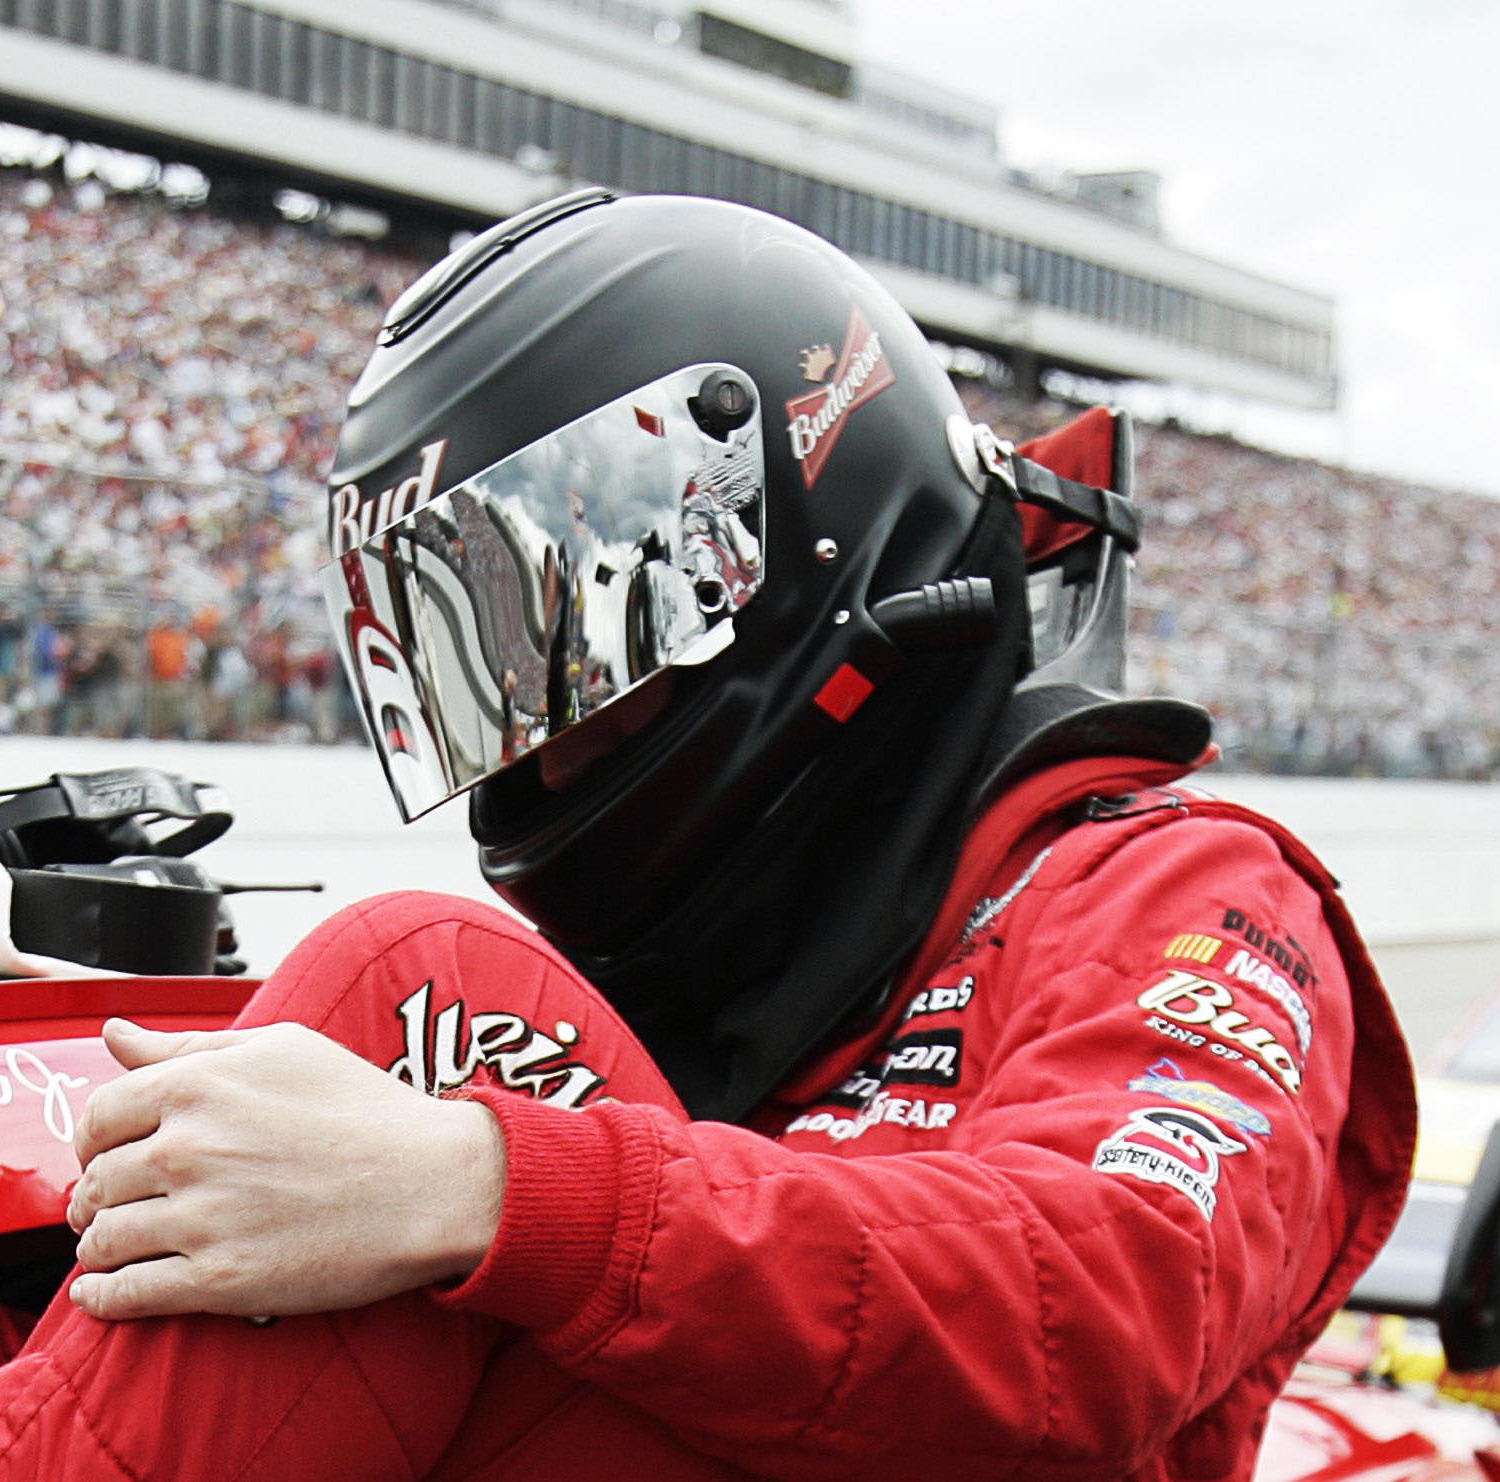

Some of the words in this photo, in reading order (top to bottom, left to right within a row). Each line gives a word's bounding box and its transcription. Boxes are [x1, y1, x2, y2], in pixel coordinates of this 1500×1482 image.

[786, 330, 883, 460] Budweiser
[331, 438, 451, 560] Bud
[1137, 968, 1303, 1096] Bud
[1145, 1015, 1207, 1049] KING
